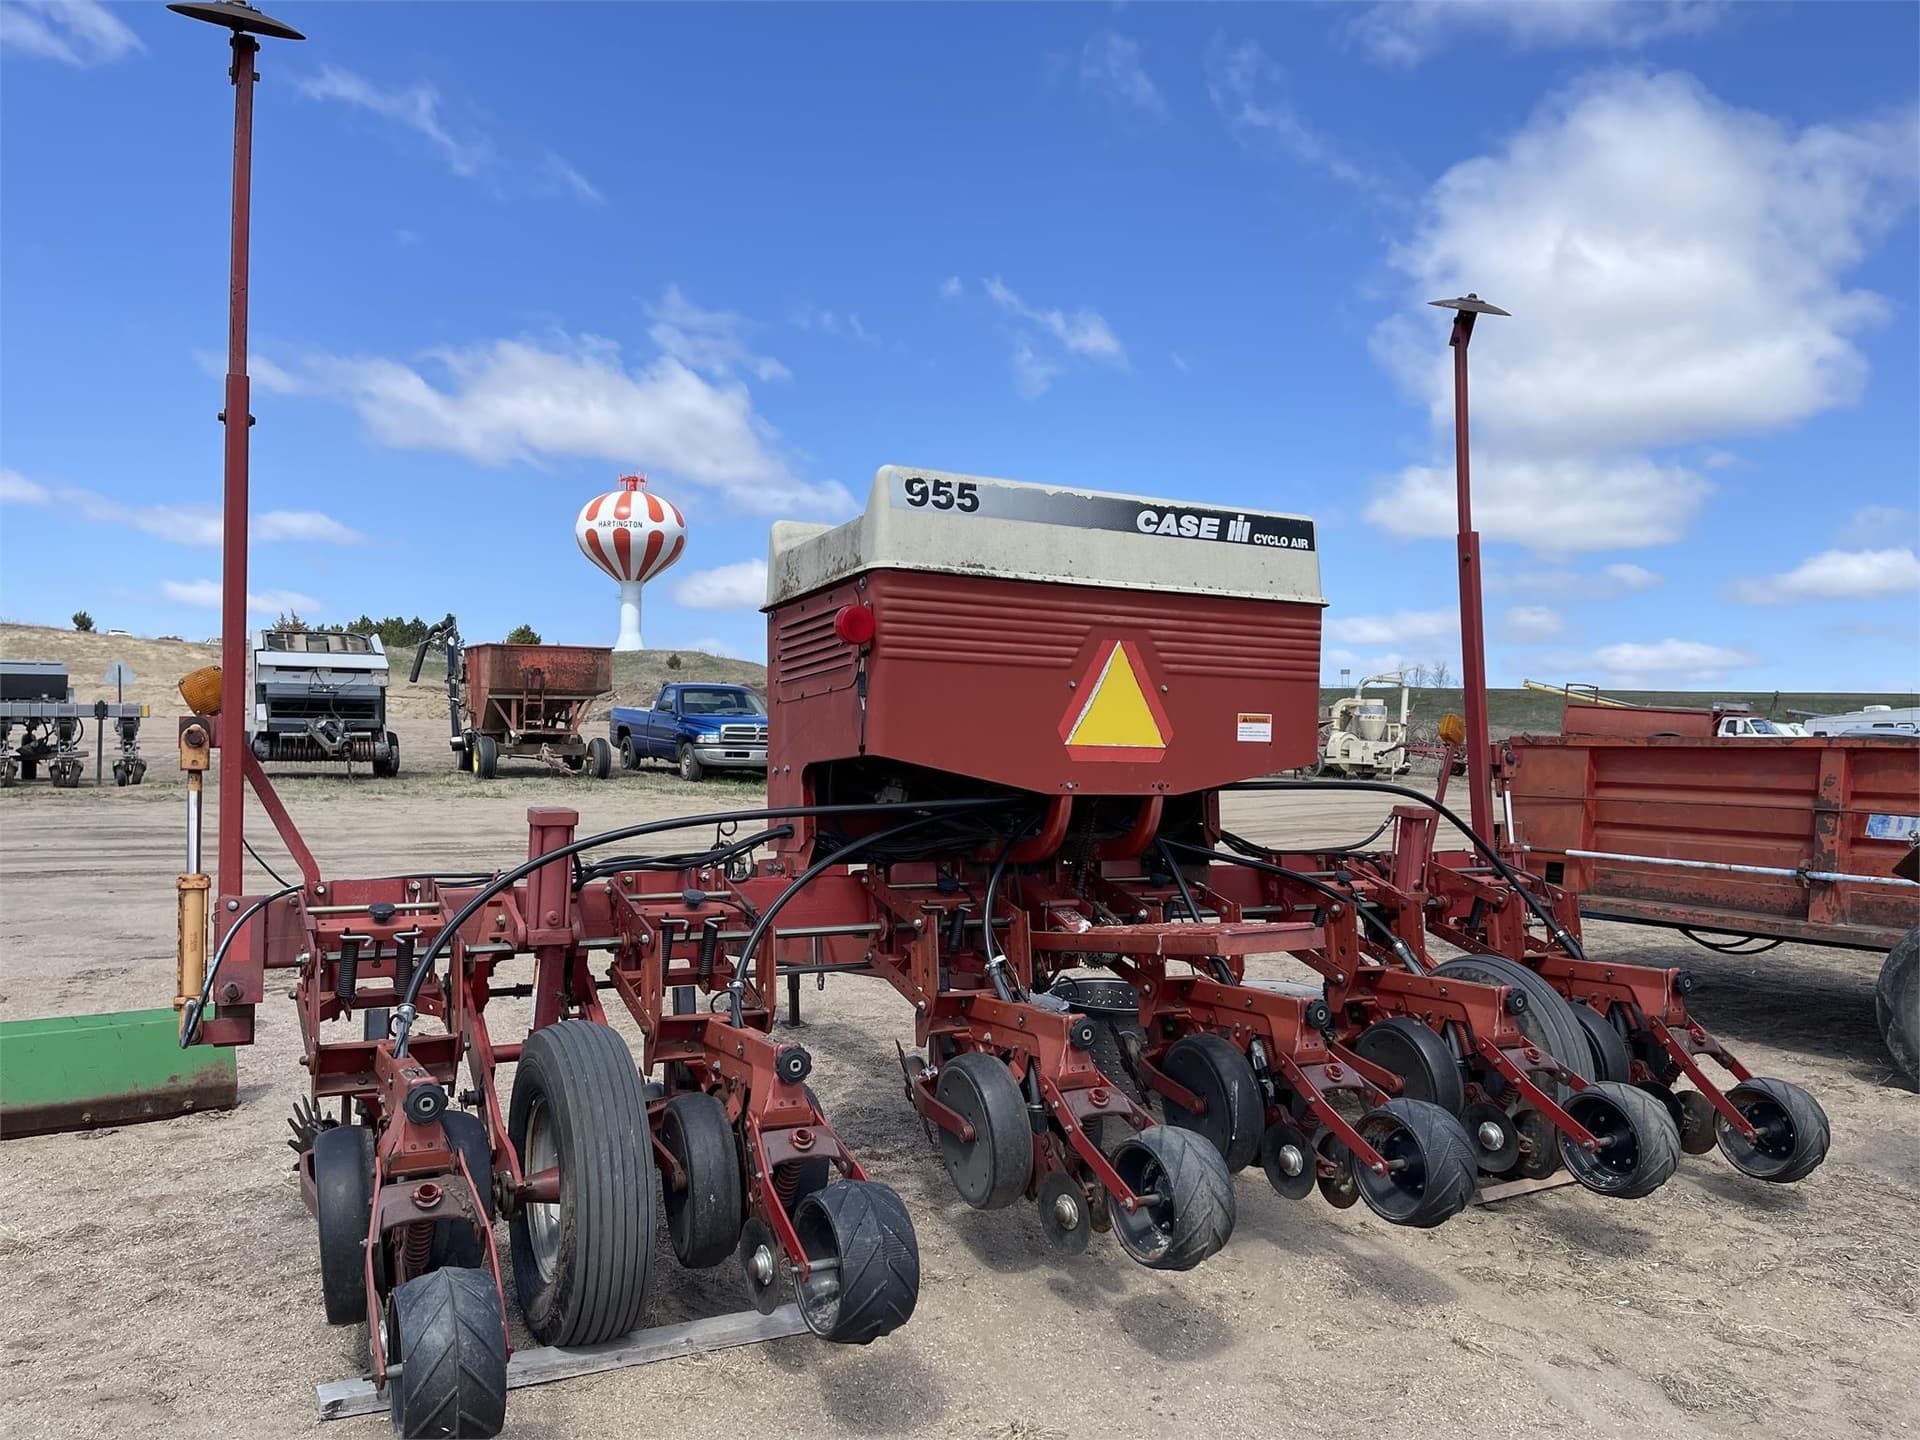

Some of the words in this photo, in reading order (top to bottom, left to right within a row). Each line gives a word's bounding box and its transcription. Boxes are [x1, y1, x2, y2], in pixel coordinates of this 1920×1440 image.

[904, 477, 980, 513] 955
[598, 520, 643, 528] HARTINGTON
[1136, 510, 1220, 540] CASE
[1253, 533, 1289, 547] CYCLO
[1290, 537, 1309, 549] AIR
